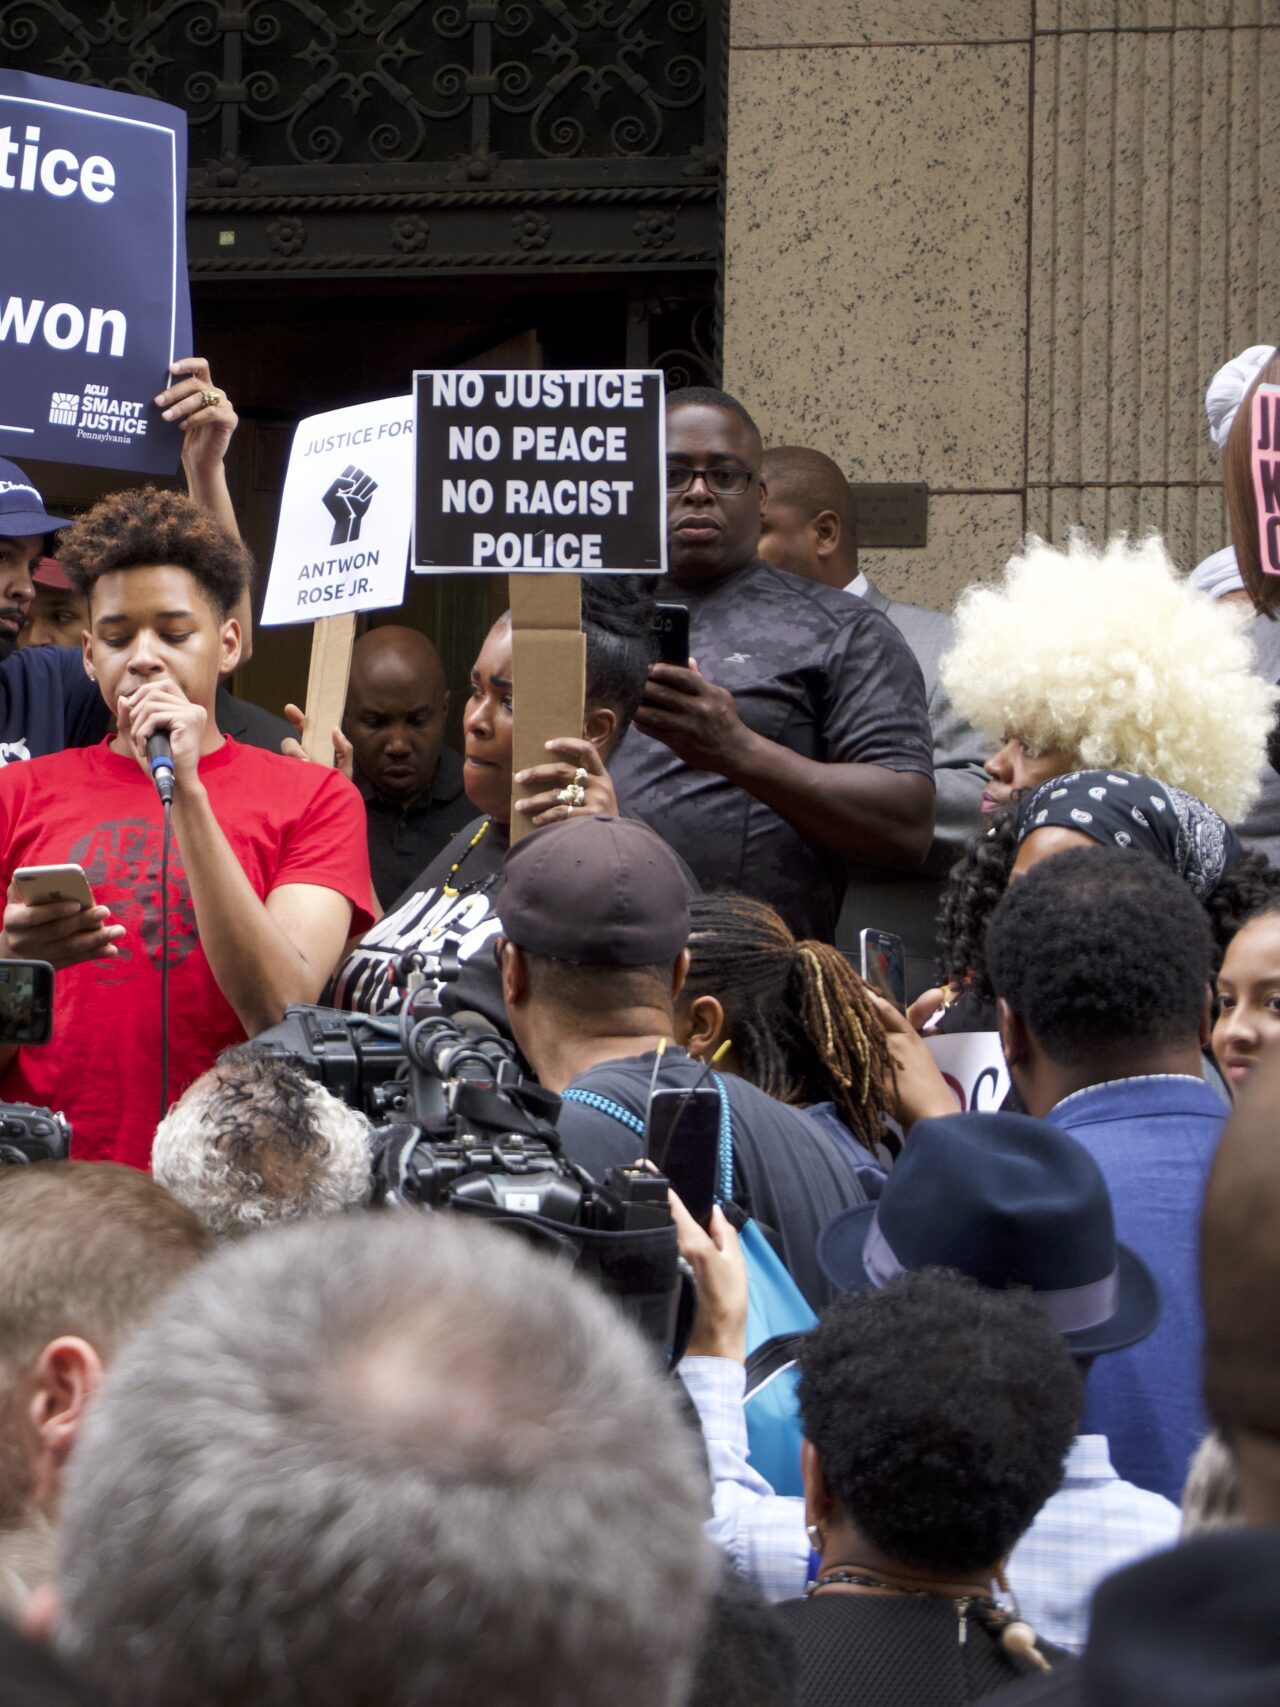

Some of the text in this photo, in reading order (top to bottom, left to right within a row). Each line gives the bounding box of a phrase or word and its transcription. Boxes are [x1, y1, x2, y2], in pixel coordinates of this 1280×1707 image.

[84, 384, 109, 396] ACLU
[432, 373, 644, 408] NO JUSTICE
[81, 396, 144, 418] SMART
[76, 429, 131, 444] Pennsylvania
[78, 412, 148, 435] JUSTICE
[304, 419, 414, 456] JUSTICE FOR
[448, 426, 627, 462] NO PEACE
[441, 479, 634, 516] NO RACIST
[298, 550, 380, 581] ANTWON
[472, 533, 603, 568] POLICE
[297, 578, 374, 606] ROSE JR.
